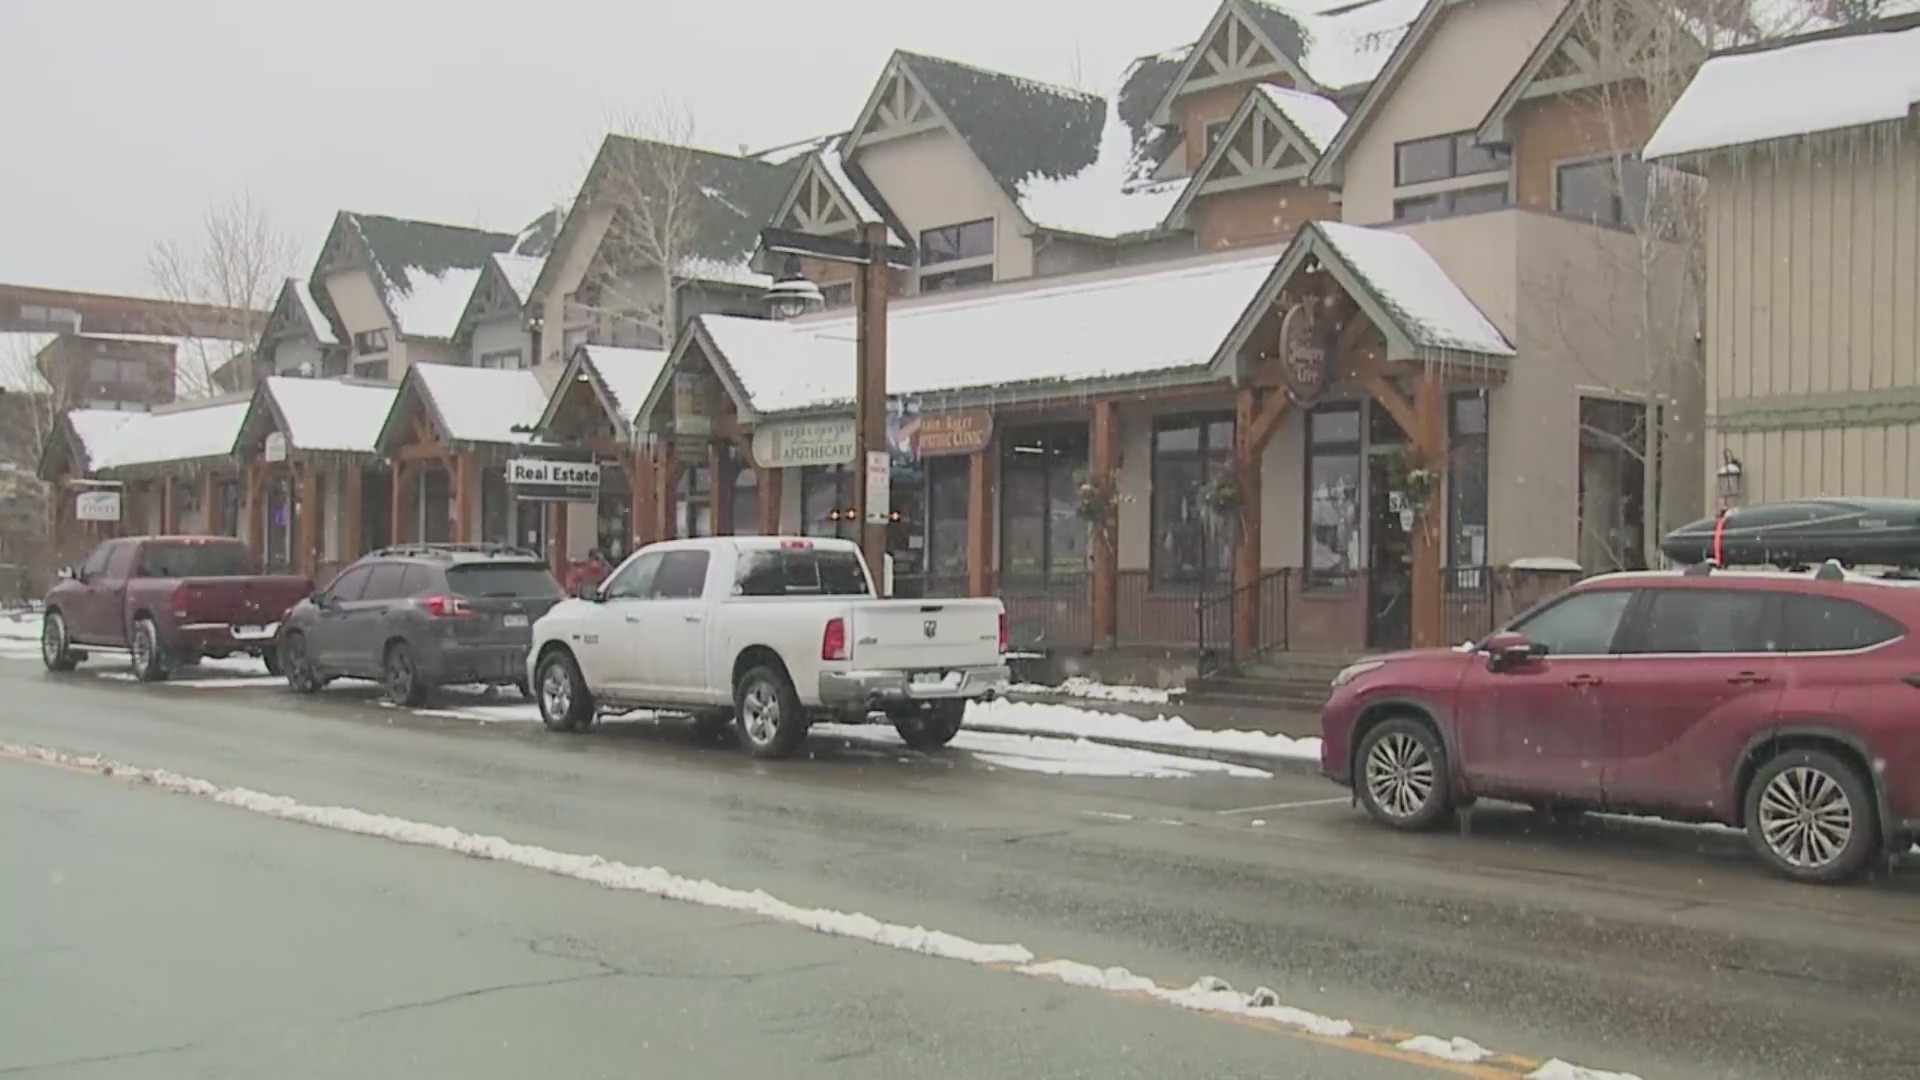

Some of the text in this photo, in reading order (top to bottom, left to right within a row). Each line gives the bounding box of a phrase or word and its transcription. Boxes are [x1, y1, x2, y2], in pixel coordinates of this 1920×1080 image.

[784, 445, 852, 459] APOTHECARY
[515, 465, 599, 482] Real Estate
